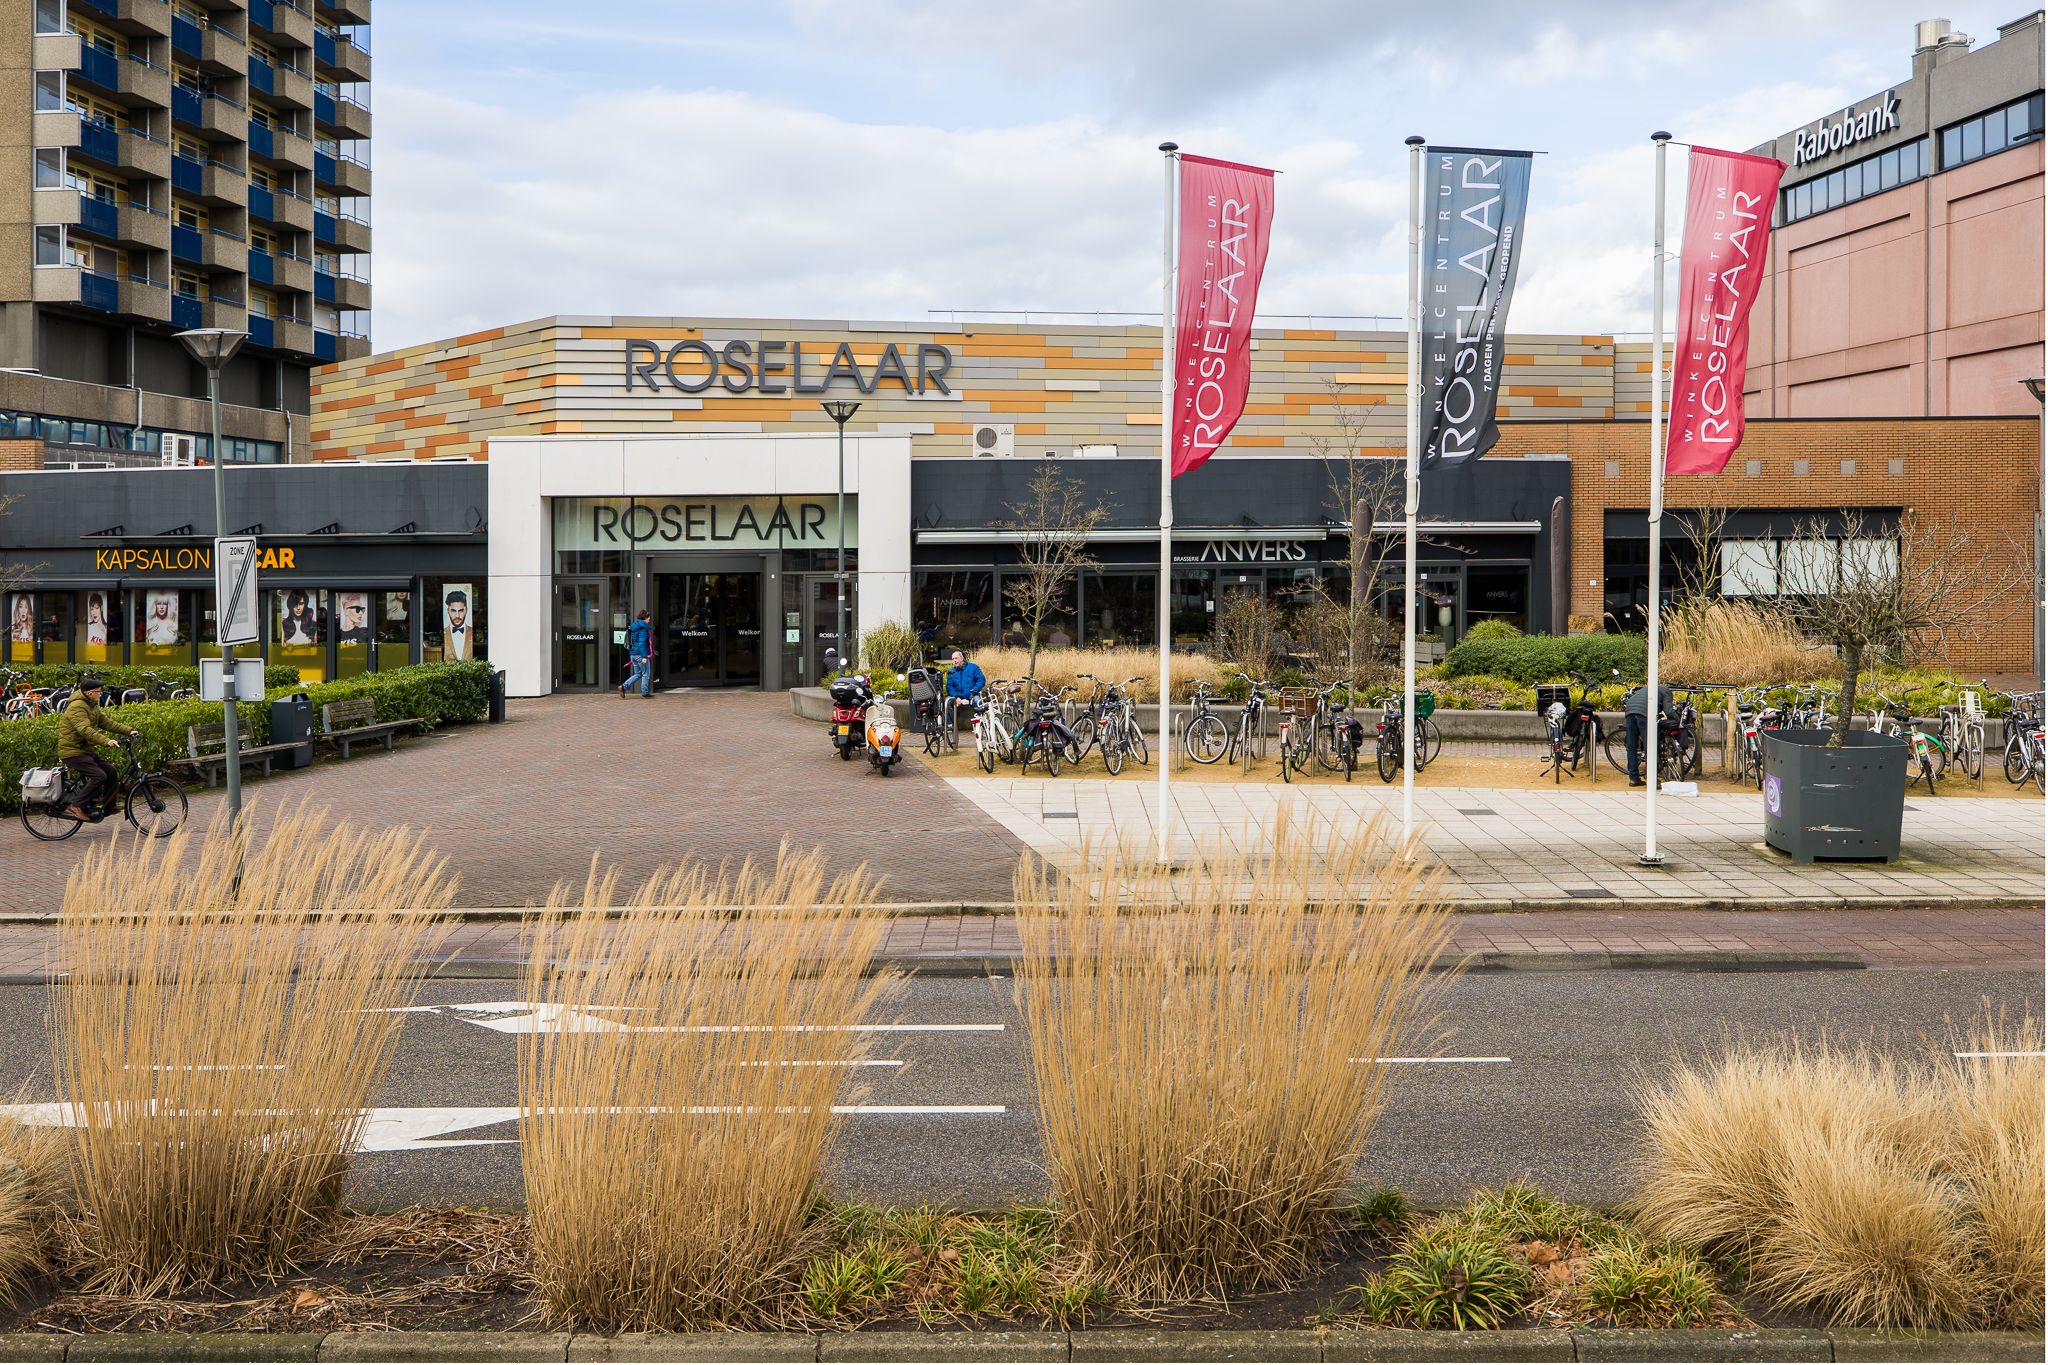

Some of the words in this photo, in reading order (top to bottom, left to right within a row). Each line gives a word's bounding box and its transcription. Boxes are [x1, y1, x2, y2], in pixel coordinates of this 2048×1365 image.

[1794, 90, 1901, 166] Rabobank
[1500, 226, 1513, 281] GEOPEND
[1182, 194, 1217, 448] WINKELCENTRUM
[1193, 198, 1250, 449] ROSELAAR
[1427, 155, 1454, 459] WINKELCENTRUM
[1441, 157, 1503, 459] ROSELAAR
[1487, 318, 1496, 341] PER
[1684, 186, 1727, 443] WINKELCENTRUM
[1700, 190, 1761, 445] ROSELAAR
[625, 339, 952, 395] ROSELAAR
[1484, 343, 1493, 383] DAGEN
[229, 546, 245, 556] ZONE
[593, 504, 825, 542] ROSELAAR
[1200, 541, 1306, 561] ANVERS
[96, 548, 210, 570] KAPSALON
[256, 547, 296, 569] CAR
